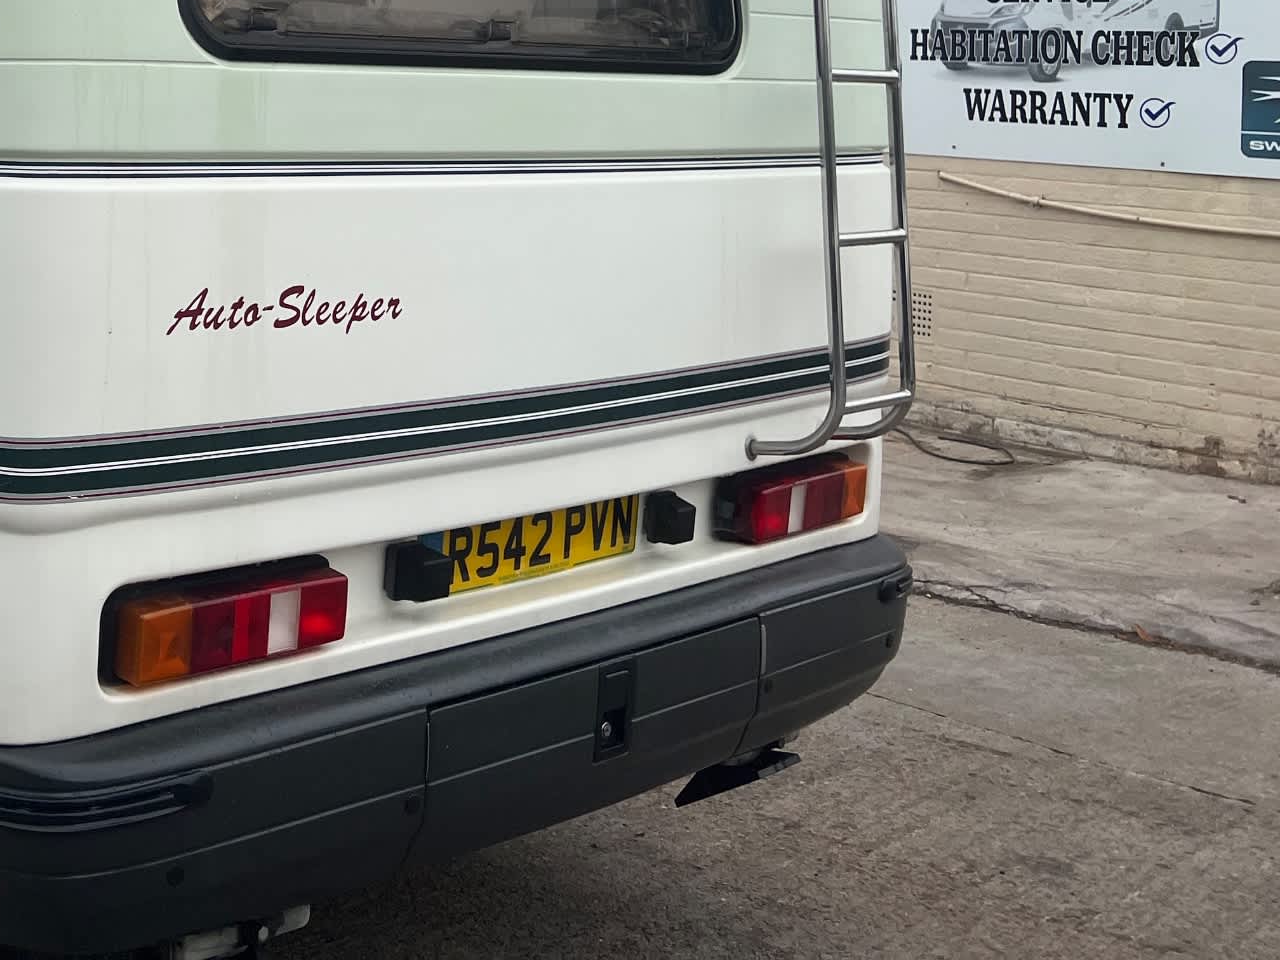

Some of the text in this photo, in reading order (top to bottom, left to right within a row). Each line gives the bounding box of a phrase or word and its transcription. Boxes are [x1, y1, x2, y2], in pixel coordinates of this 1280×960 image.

[909, 28, 1200, 68] HABITATION CHECK
[963, 87, 1134, 129] WARRANTY
[166, 285, 403, 336] Auto-Sleeper
[449, 493, 634, 584] R542 PVN
